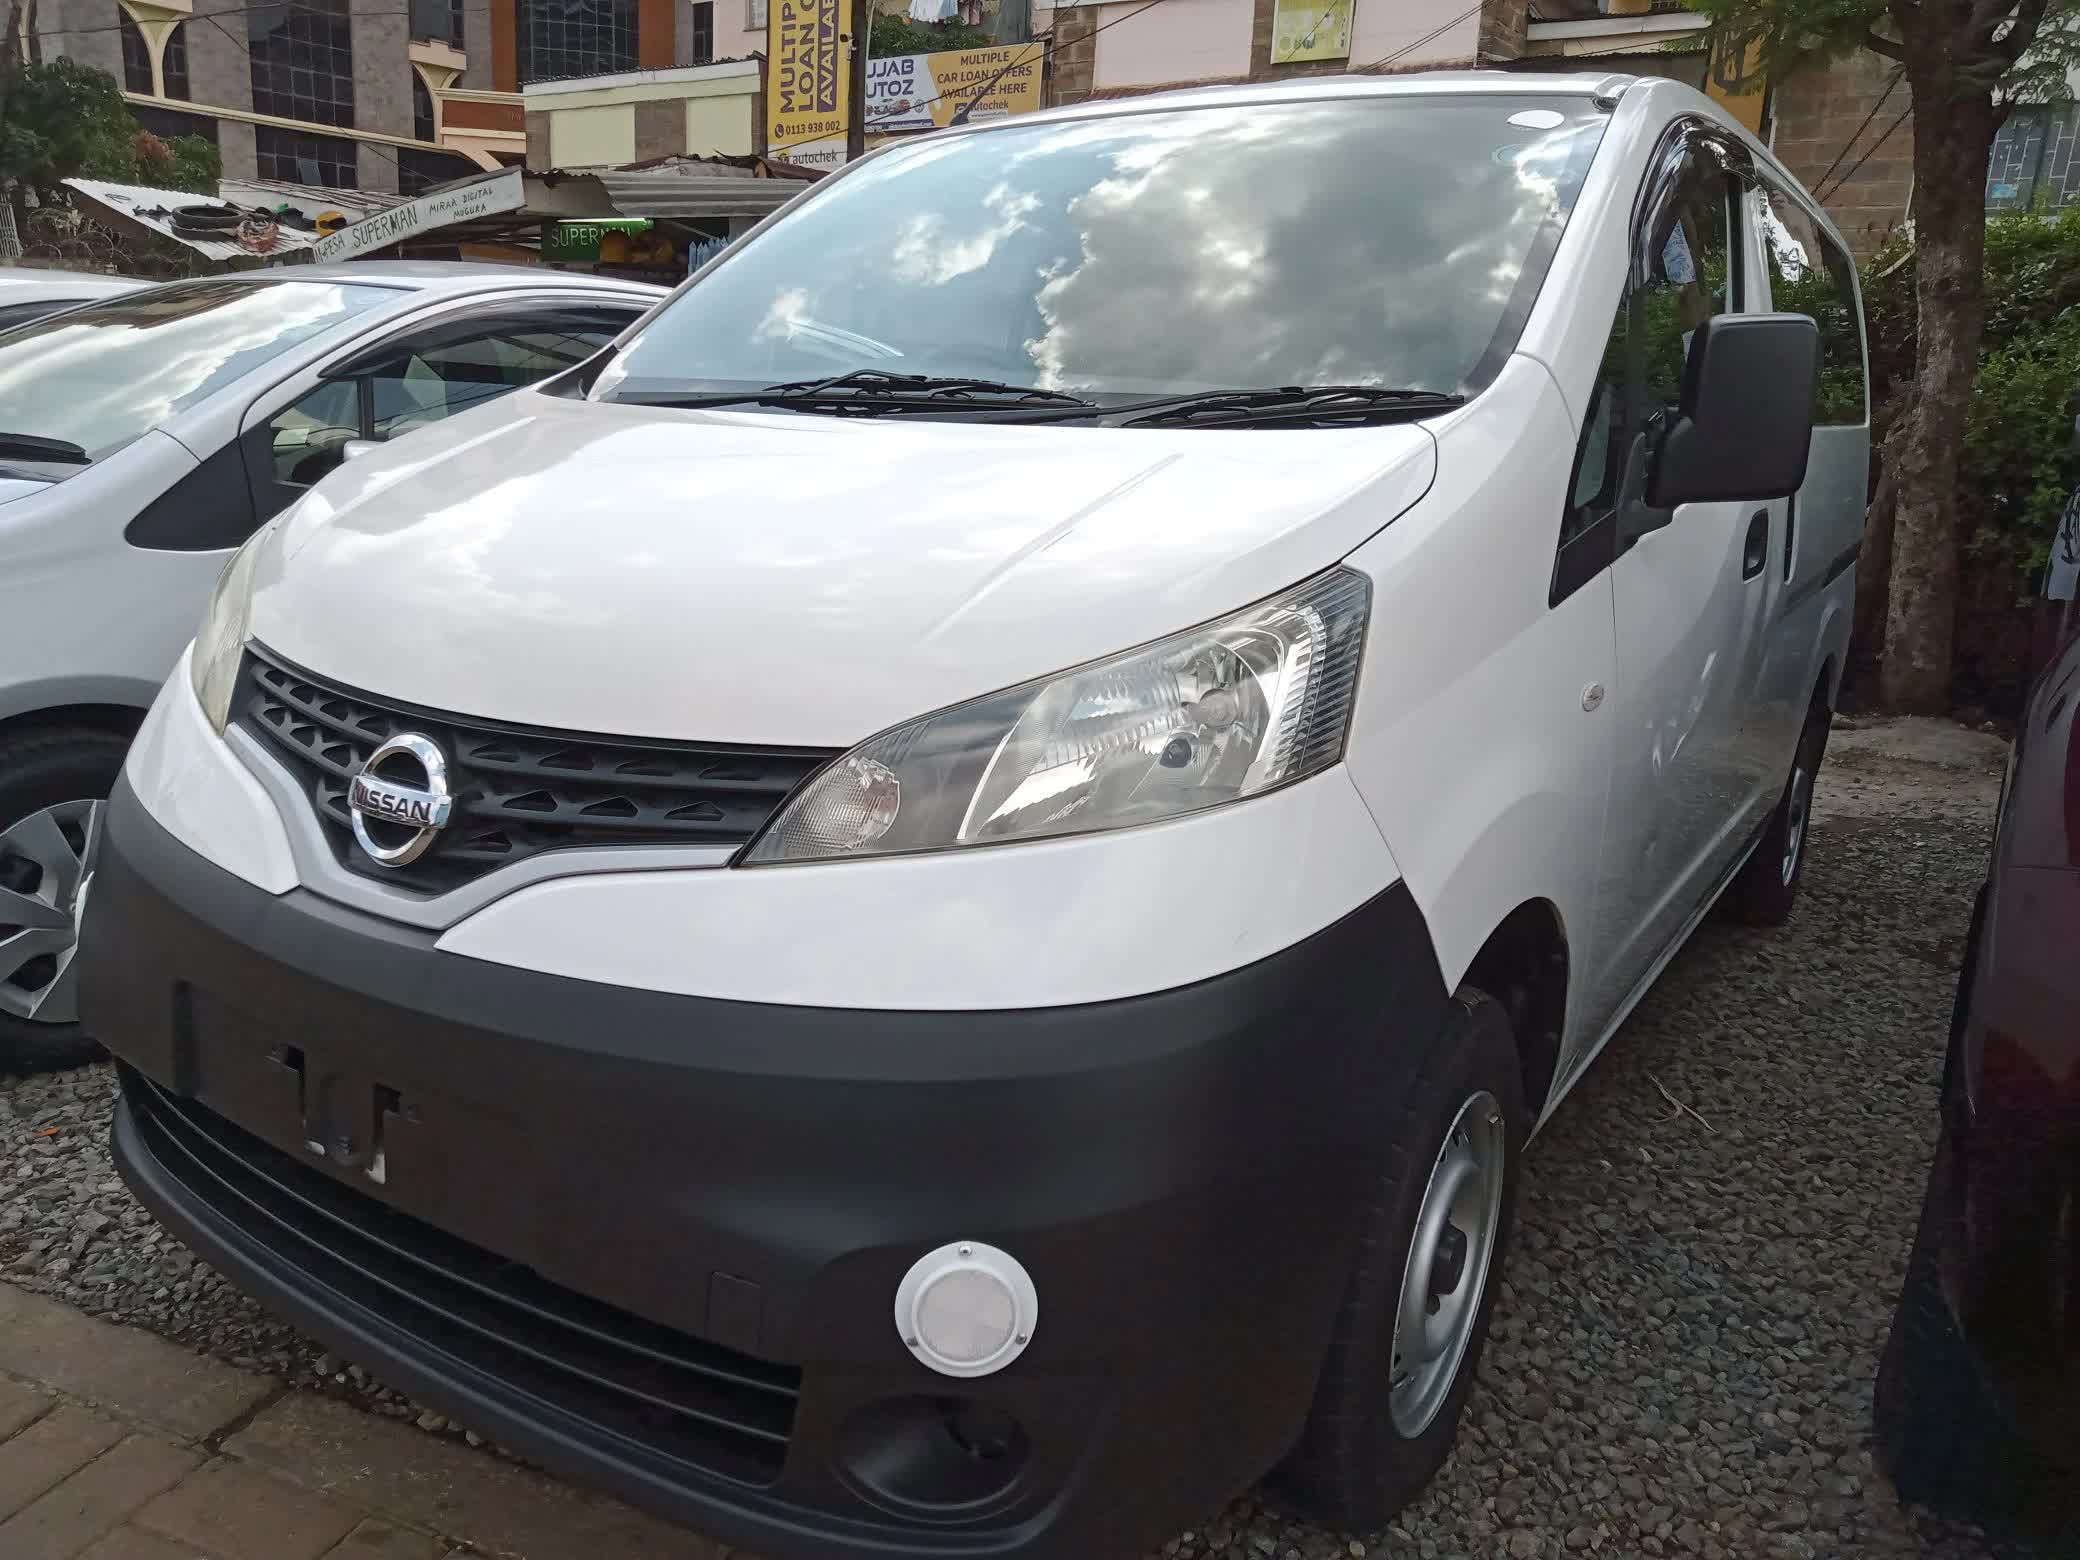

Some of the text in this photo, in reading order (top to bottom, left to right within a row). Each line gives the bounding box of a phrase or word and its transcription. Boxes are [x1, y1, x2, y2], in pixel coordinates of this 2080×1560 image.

[960, 50, 1010, 66] MULTIPLE
[799, 23, 815, 112] LOAN
[937, 73, 958, 84] CAR
[961, 69, 989, 82] LOAN
[1000, 82, 1027, 95] HERE
[786, 120, 840, 135] 0113 938 002
[792, 148, 838, 165] autochek
[463, 187, 493, 204] DIGITAL
[352, 204, 418, 248] SUPERMAN
[354, 781, 432, 823] NISSAN
